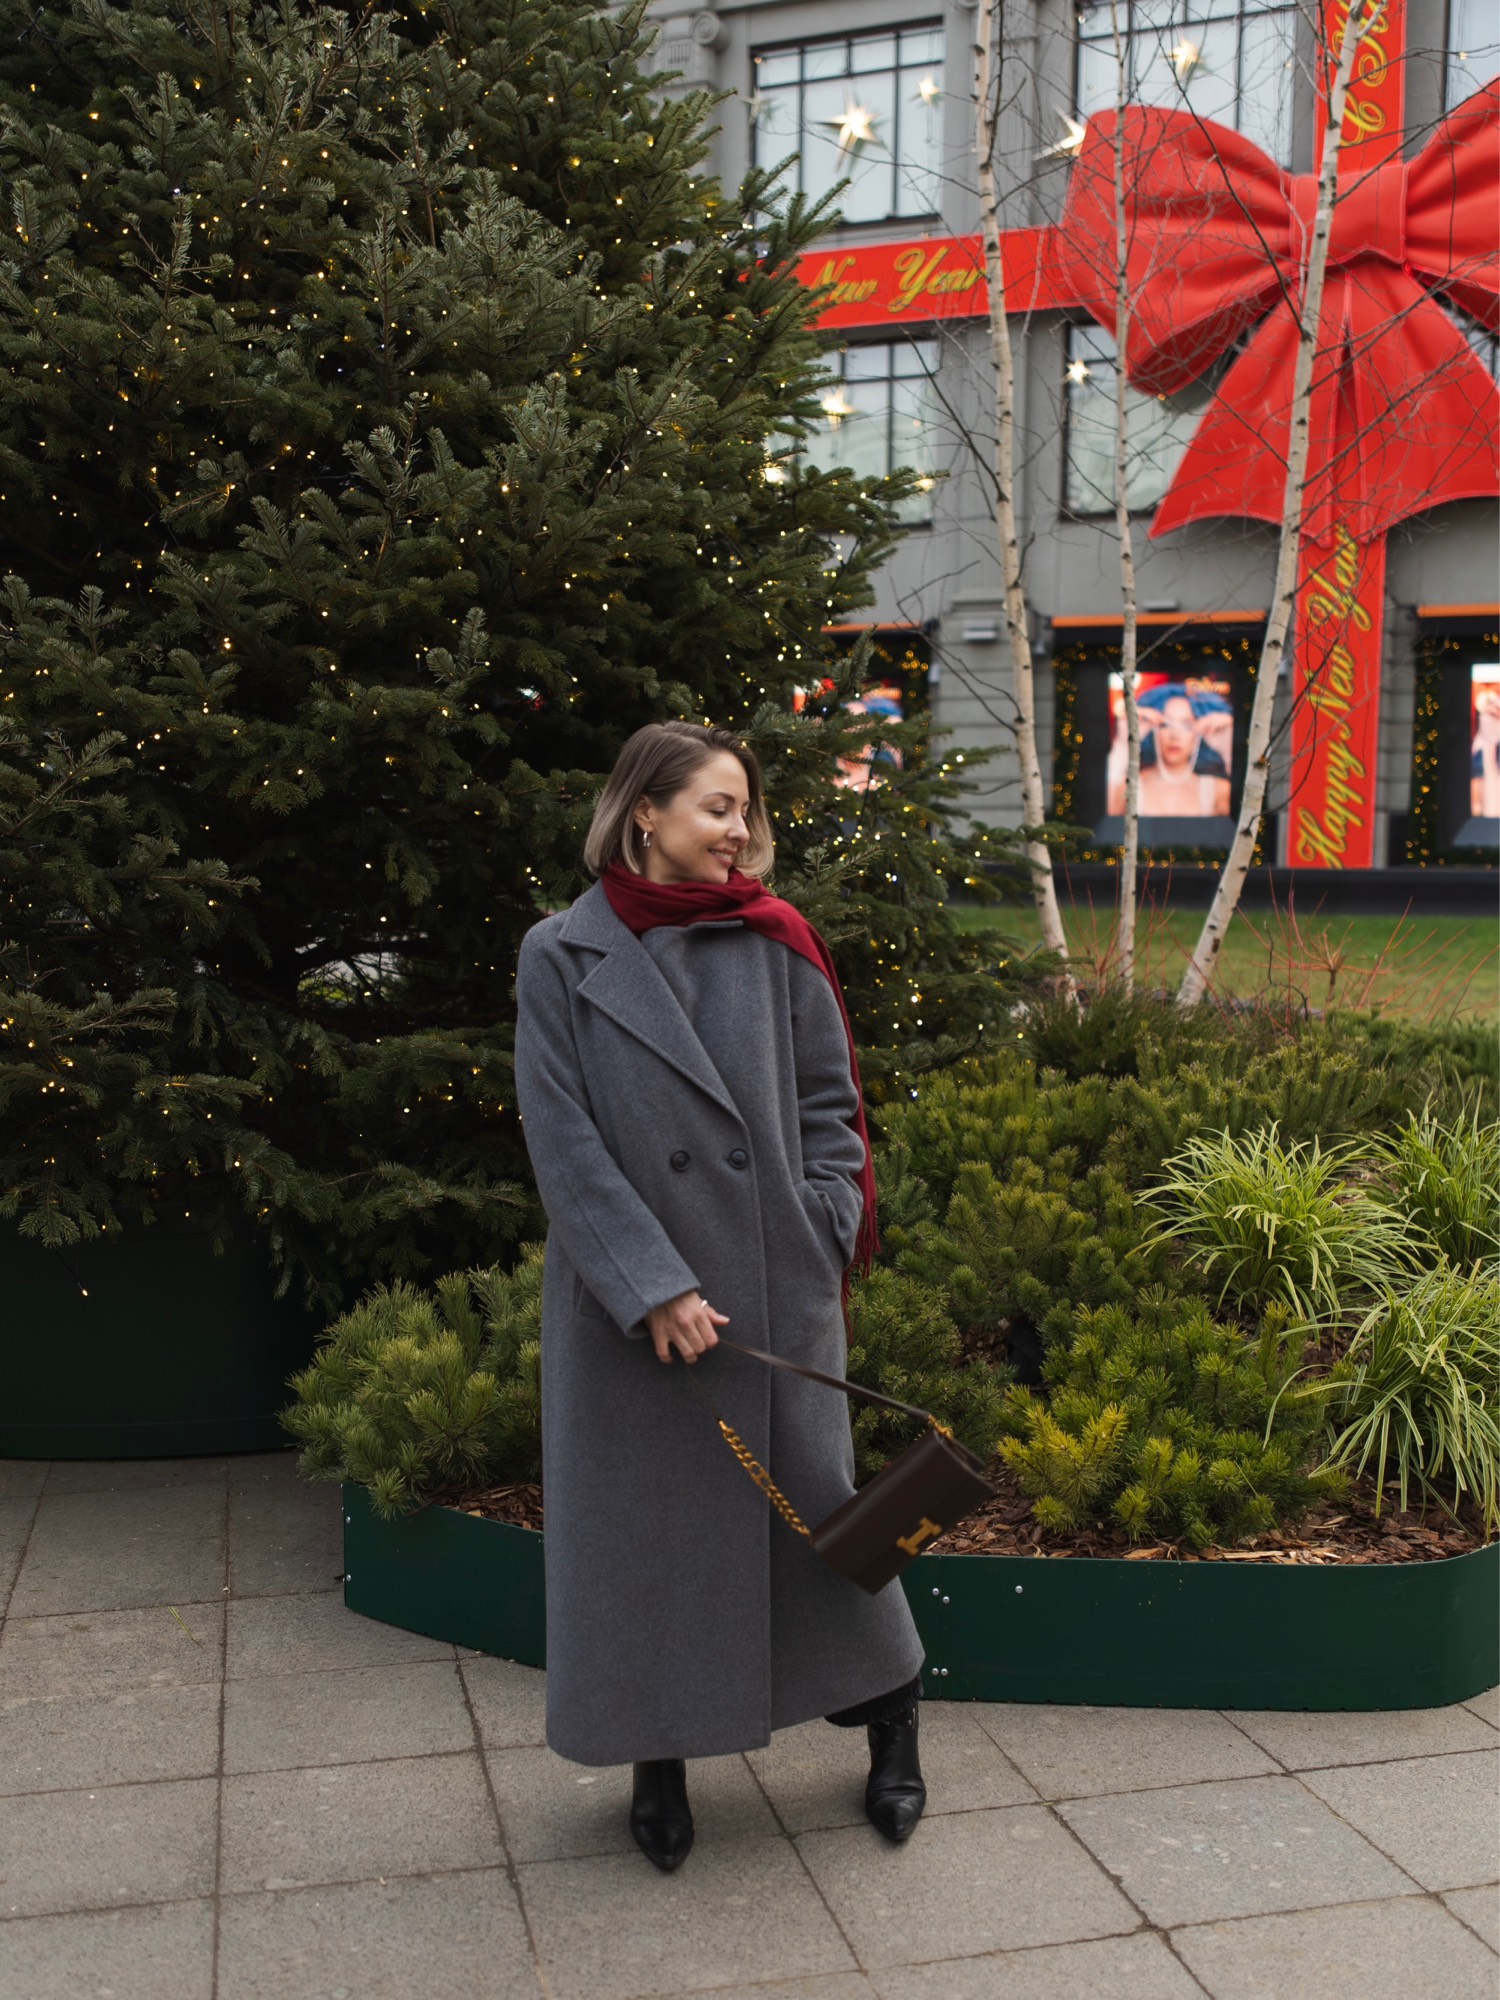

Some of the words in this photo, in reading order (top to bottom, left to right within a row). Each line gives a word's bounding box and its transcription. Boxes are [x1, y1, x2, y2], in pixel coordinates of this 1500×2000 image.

[887, 245, 987, 313] Year
[1307, 522, 1372, 632] Year
[1305, 644, 1356, 741] New
[1298, 740, 1366, 869] Happy
